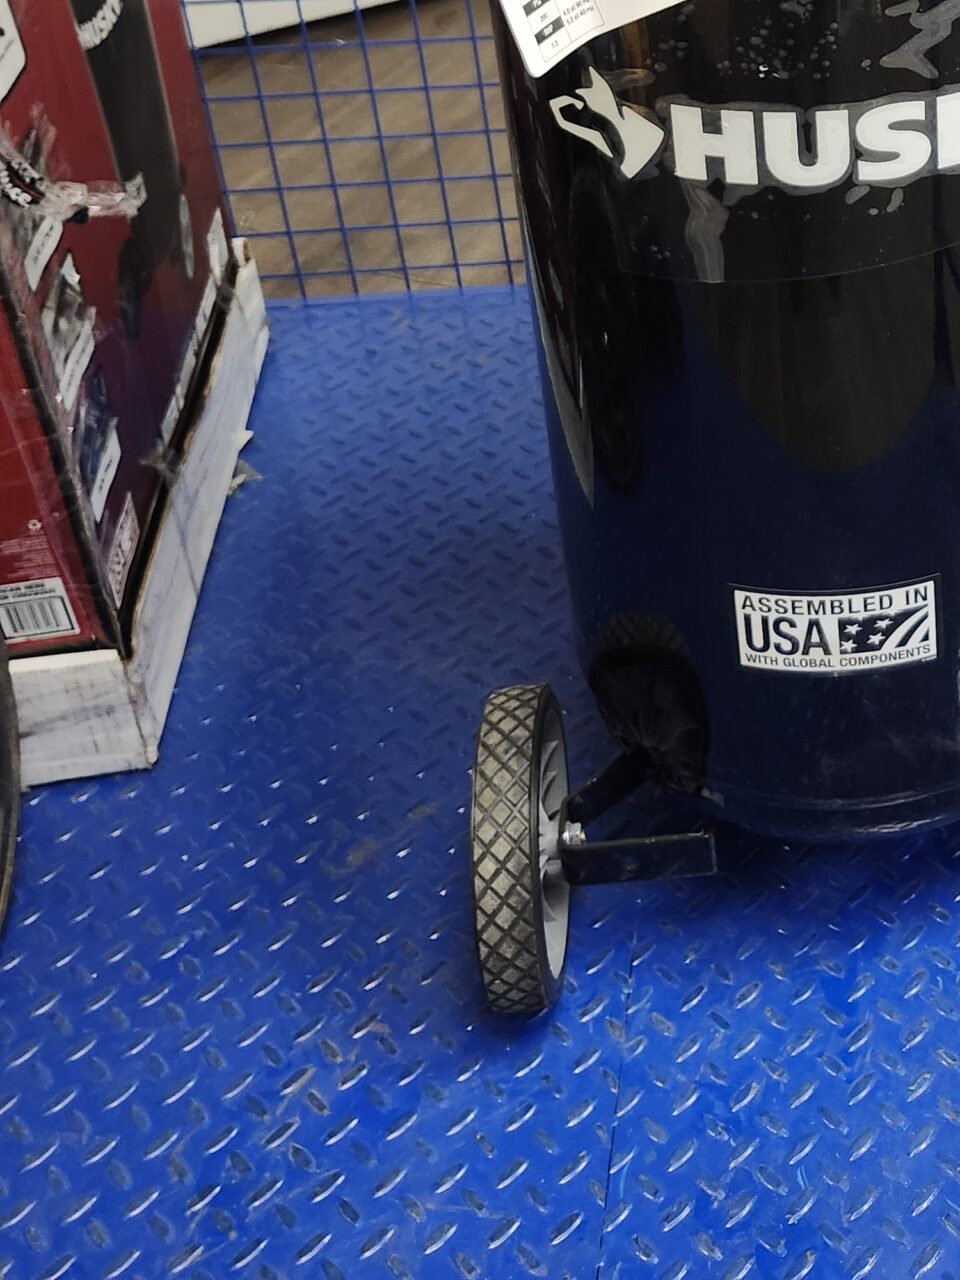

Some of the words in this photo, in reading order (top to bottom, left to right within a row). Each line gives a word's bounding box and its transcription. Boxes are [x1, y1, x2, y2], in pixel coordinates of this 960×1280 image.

[741, 593, 893, 616] ASSEMBLED
[905, 586, 929, 605] IN
[743, 613, 832, 656] USA
[745, 653, 778, 667] WITH
[783, 657, 836, 668] GLOBAL
[839, 643, 931, 667] COMPONENTS
